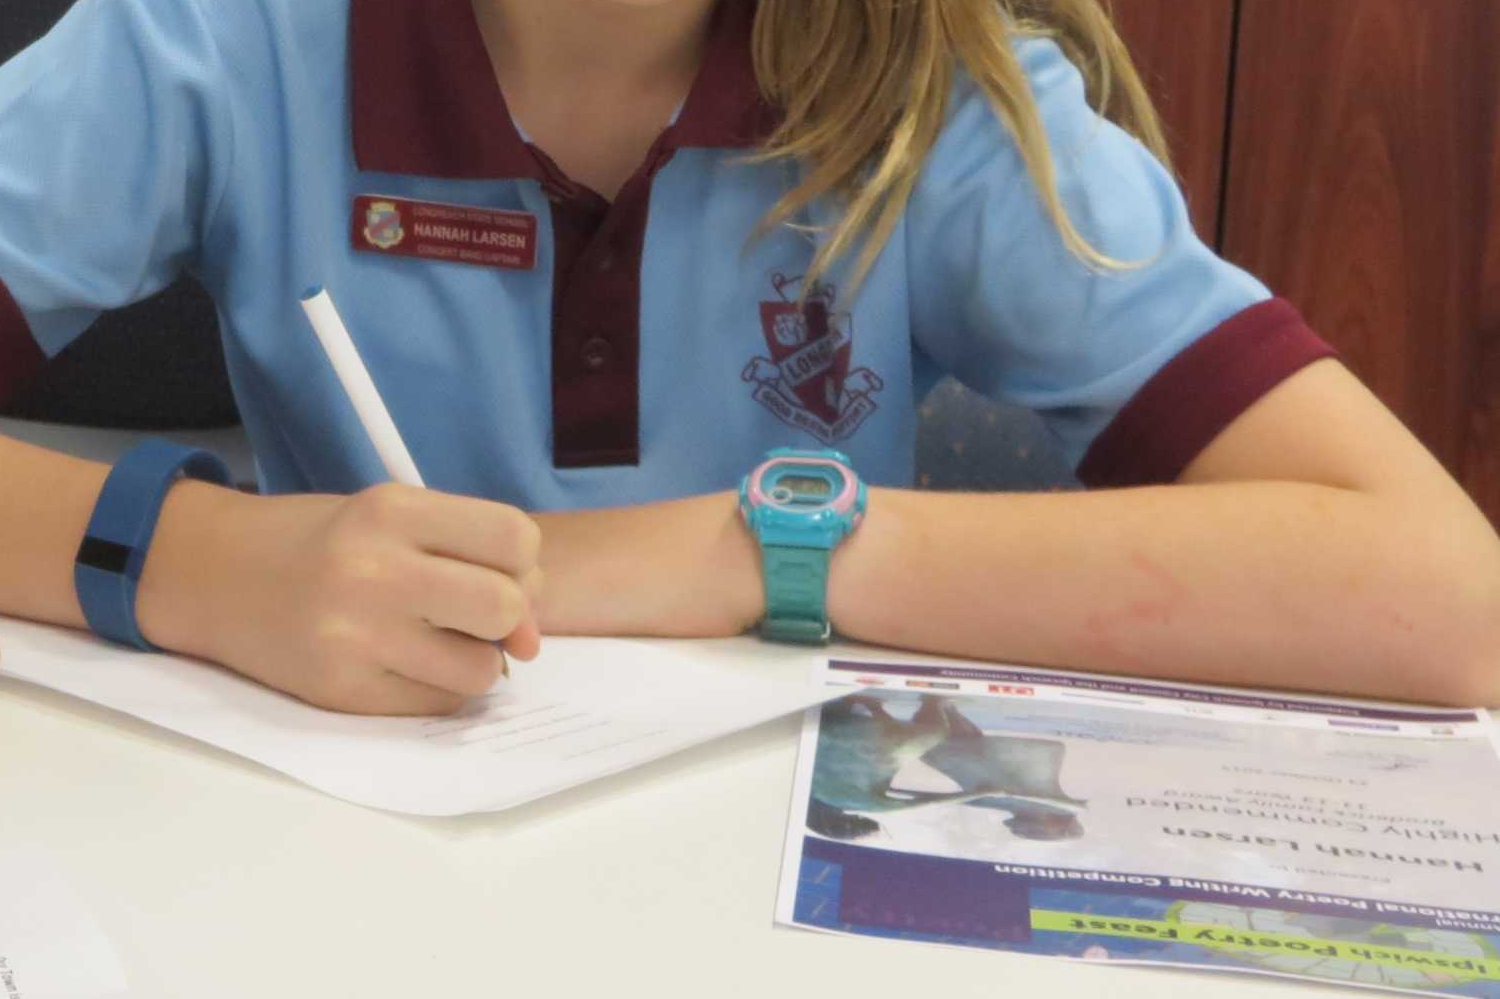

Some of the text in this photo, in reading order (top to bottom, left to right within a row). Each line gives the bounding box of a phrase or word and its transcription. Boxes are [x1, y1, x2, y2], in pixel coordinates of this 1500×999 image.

[413, 223, 527, 250] HANNAH LARSEN
[1126, 797, 1500, 844] Highly Commended
[1162, 826, 1484, 873] Hannah Larsen
[994, 864, 1162, 887] Competition
[1168, 876, 1270, 898] Writing
[1278, 889, 1368, 910] Poetry
[1069, 919, 1487, 974] Ipswich Poetry Feast
[0, 969, 18, 993] Town
